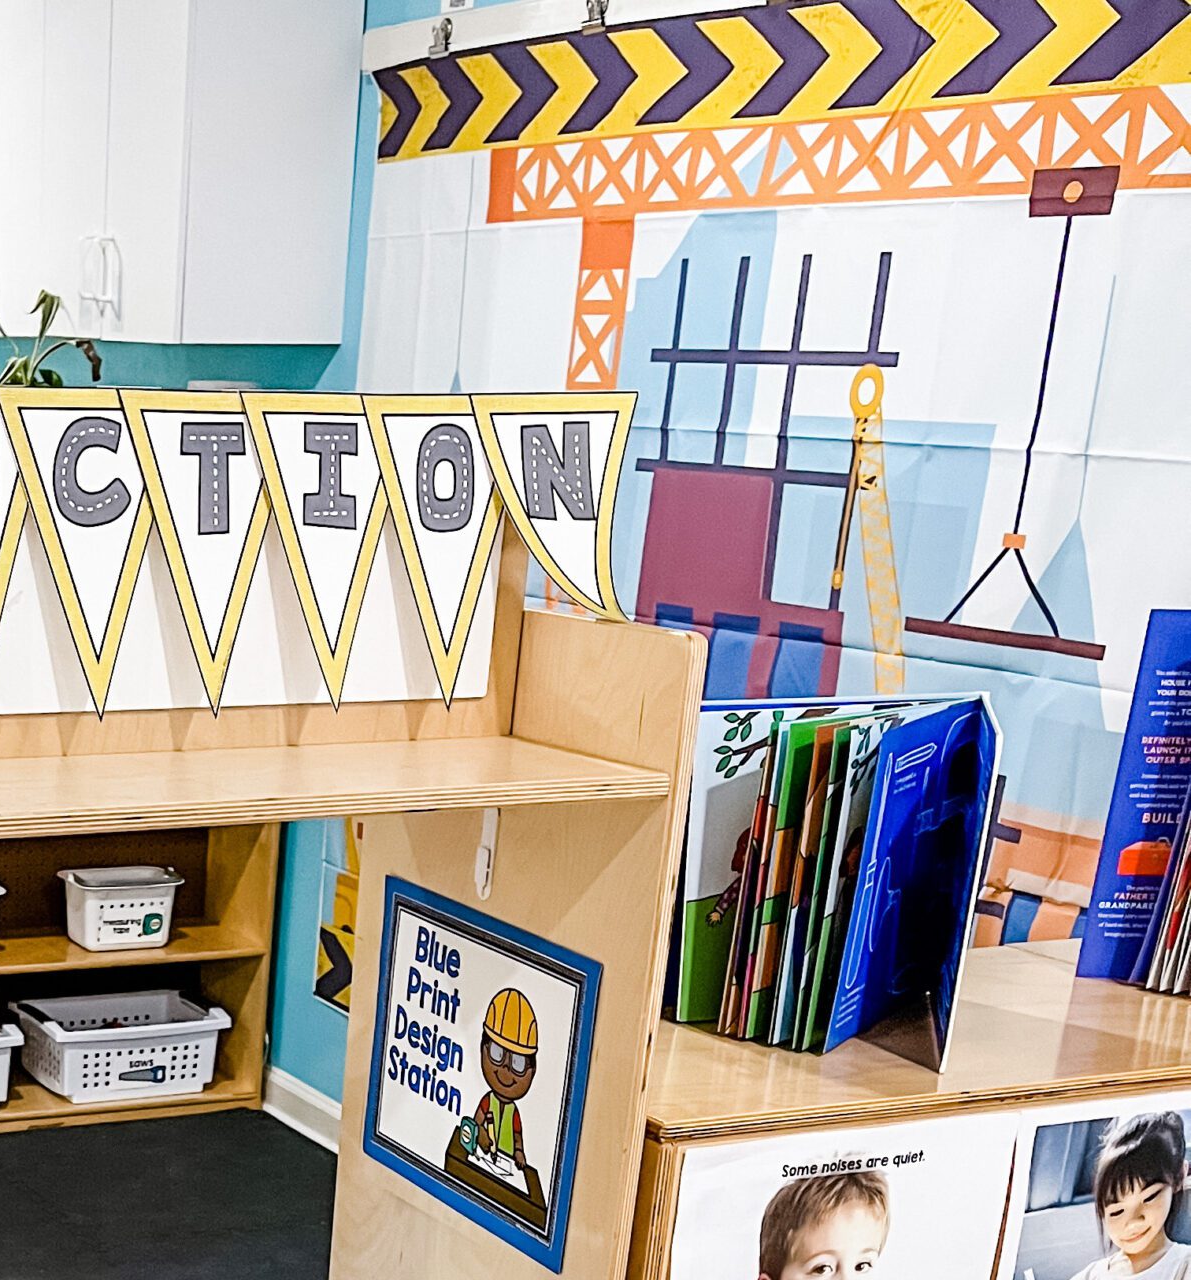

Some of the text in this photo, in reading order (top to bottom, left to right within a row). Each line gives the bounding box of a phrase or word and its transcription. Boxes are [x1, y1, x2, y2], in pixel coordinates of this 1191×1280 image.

[102, 918, 142, 927] measuring
[414, 925, 462, 979] Blue
[406, 967, 461, 1025] Print
[128, 1059, 154, 1069] saws
[394, 1004, 464, 1073] Design
[387, 1049, 462, 1117] Station
[781, 1149, 926, 1178] Some noises are quiet.
